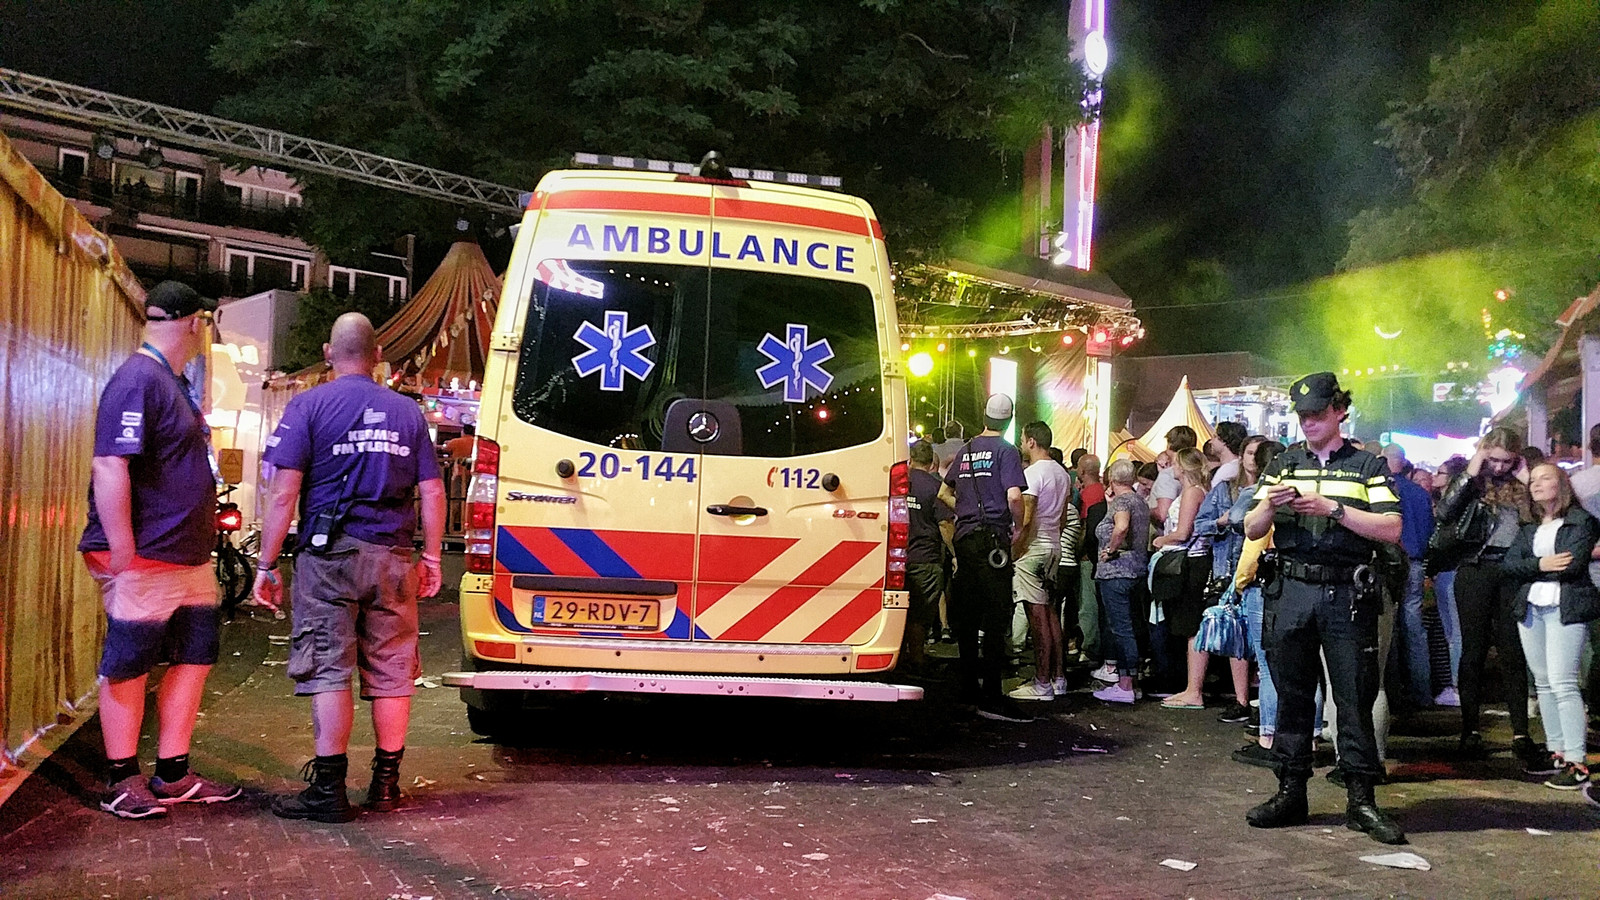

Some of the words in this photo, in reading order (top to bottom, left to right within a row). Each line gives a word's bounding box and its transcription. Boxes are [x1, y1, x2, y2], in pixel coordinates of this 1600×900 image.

[567, 223, 855, 274] AMBULANCE
[347, 428, 400, 442] KERMIS
[332, 442, 355, 455] FM
[577, 451, 698, 484] 20-144
[533, 611, 544, 619] NL
[551, 601, 651, 623] 29-RDV-7
